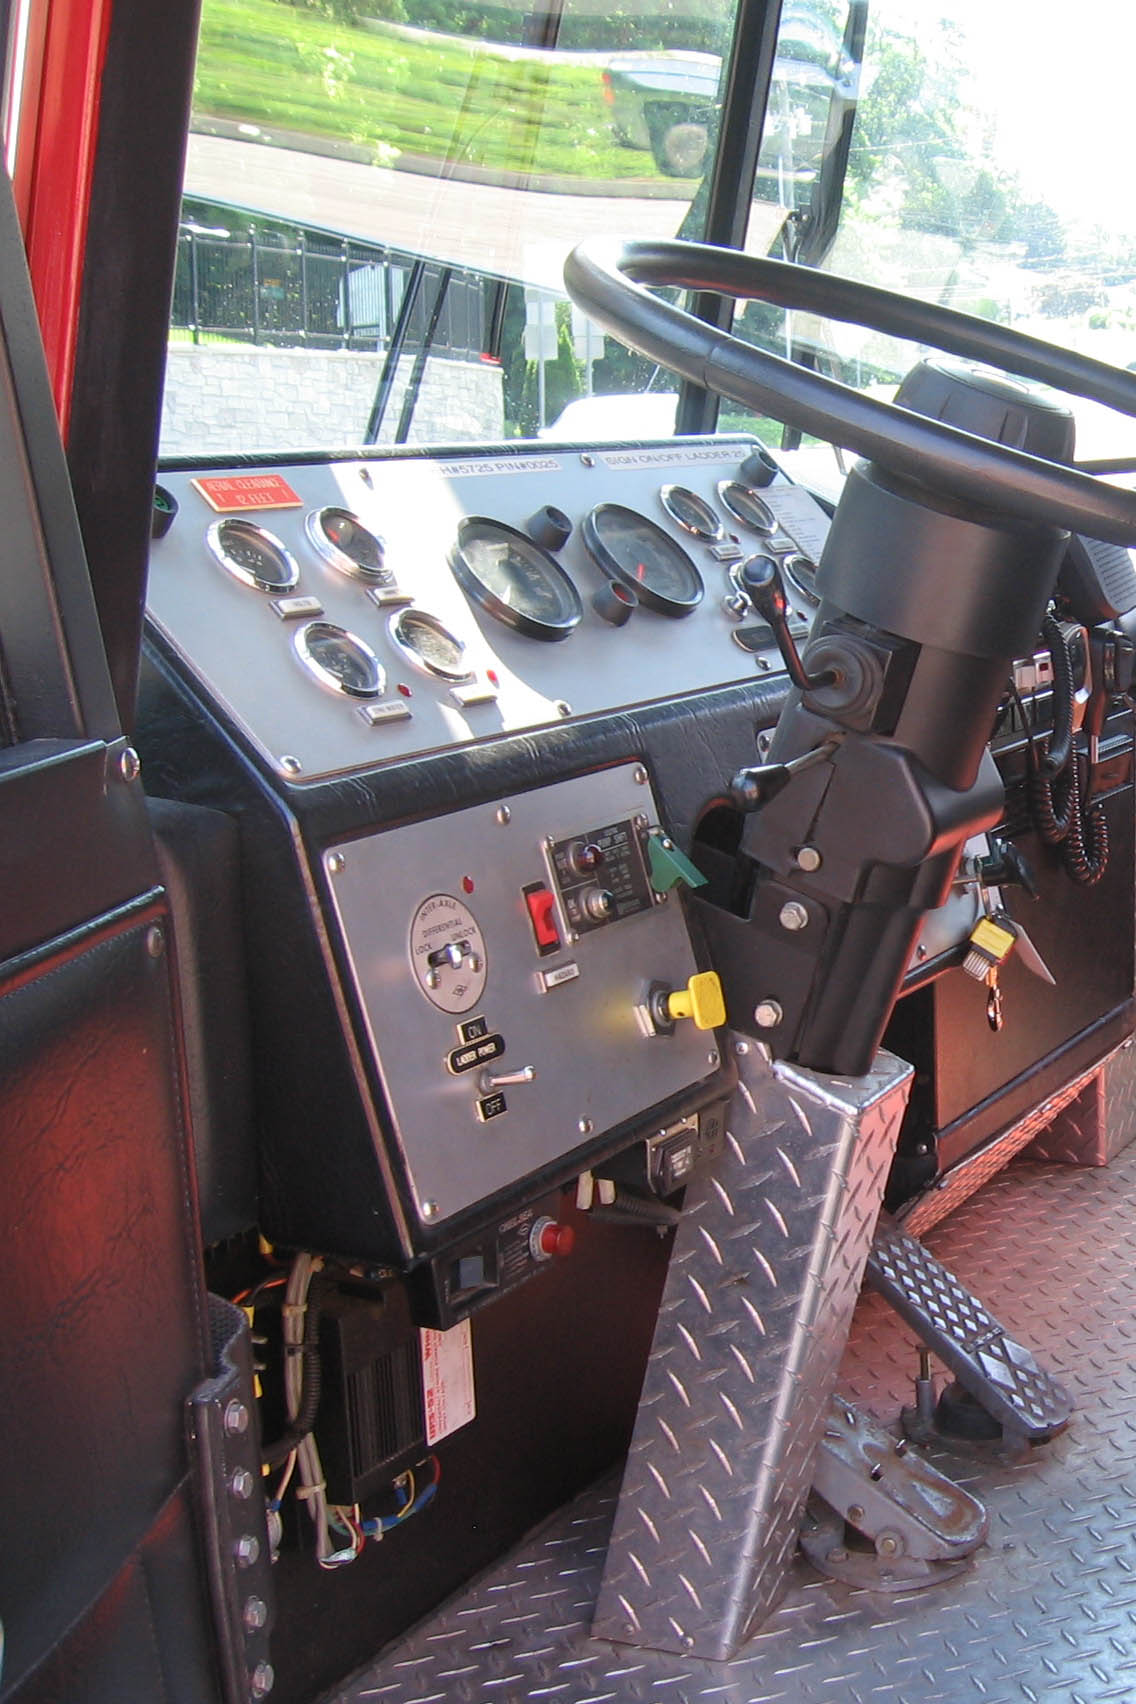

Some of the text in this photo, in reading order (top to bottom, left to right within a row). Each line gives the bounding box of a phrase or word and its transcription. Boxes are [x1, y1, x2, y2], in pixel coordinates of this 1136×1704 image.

[685, 451, 728, 461] LADDER
[468, 1026, 483, 1039] ON
[485, 1098, 501, 1116] OFF
